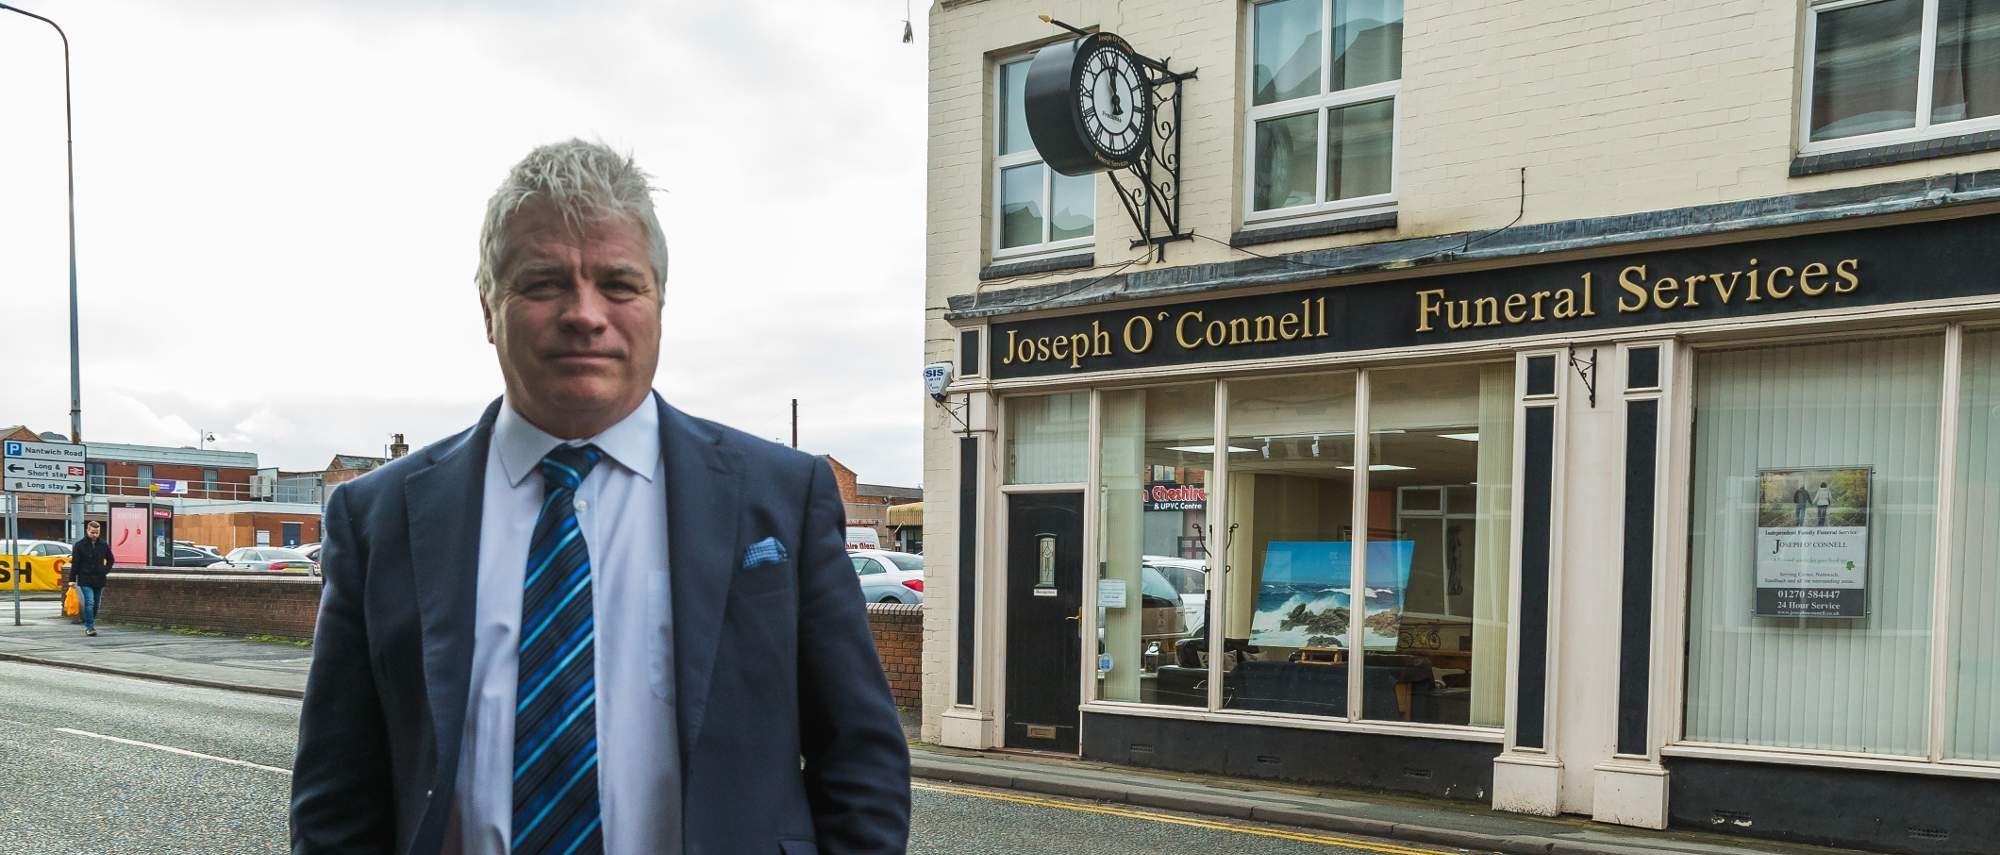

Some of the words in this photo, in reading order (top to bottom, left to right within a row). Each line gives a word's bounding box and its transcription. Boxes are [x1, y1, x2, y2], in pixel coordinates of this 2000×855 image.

[1003, 321, 1112, 368] Joseph
[1175, 297, 1329, 349] Connell
[1415, 271, 1596, 332] Funeral
[1617, 257, 1860, 313] Services
[926, 369, 944, 377] SIS
[25, 447, 62, 456] Nantwich
[64, 449, 83, 457] Road
[34, 462, 52, 470] Long
[52, 471, 67, 479] stay
[1152, 485, 1207, 501] Cheshire
[1160, 502, 1179, 510] UPVC
[1777, 590, 1805, 598] 01270
[1807, 590, 1840, 599] 584447
[1777, 601, 1787, 609] 24
[1788, 601, 1809, 609] Hour
[1811, 601, 1840, 610] Service
